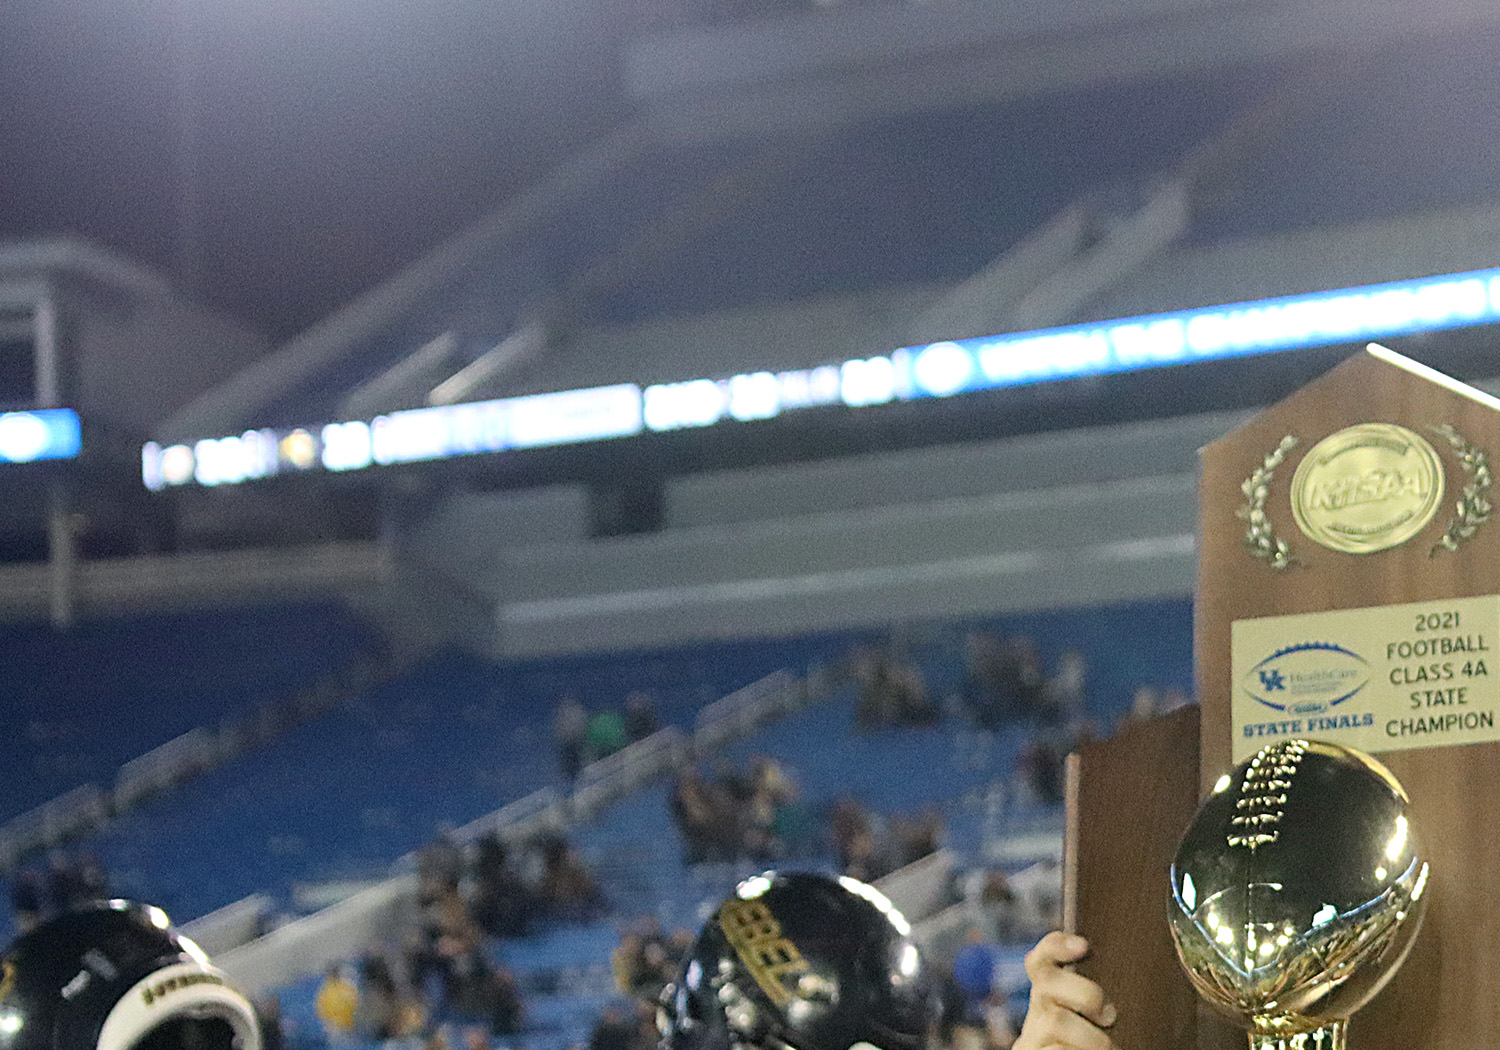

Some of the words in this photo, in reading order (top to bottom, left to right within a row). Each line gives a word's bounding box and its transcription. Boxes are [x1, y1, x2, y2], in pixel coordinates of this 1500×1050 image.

[1414, 611, 1460, 632] 2021
[1386, 634, 1490, 660] FOOTBALL
[1389, 662, 1454, 686] CLASS
[1461, 660, 1489, 678] 4A
[1410, 687, 1468, 709] STATE
[1243, 718, 1302, 738] STATE
[1307, 712, 1374, 733] FINALS
[1385, 711, 1495, 738] CHAMPION
